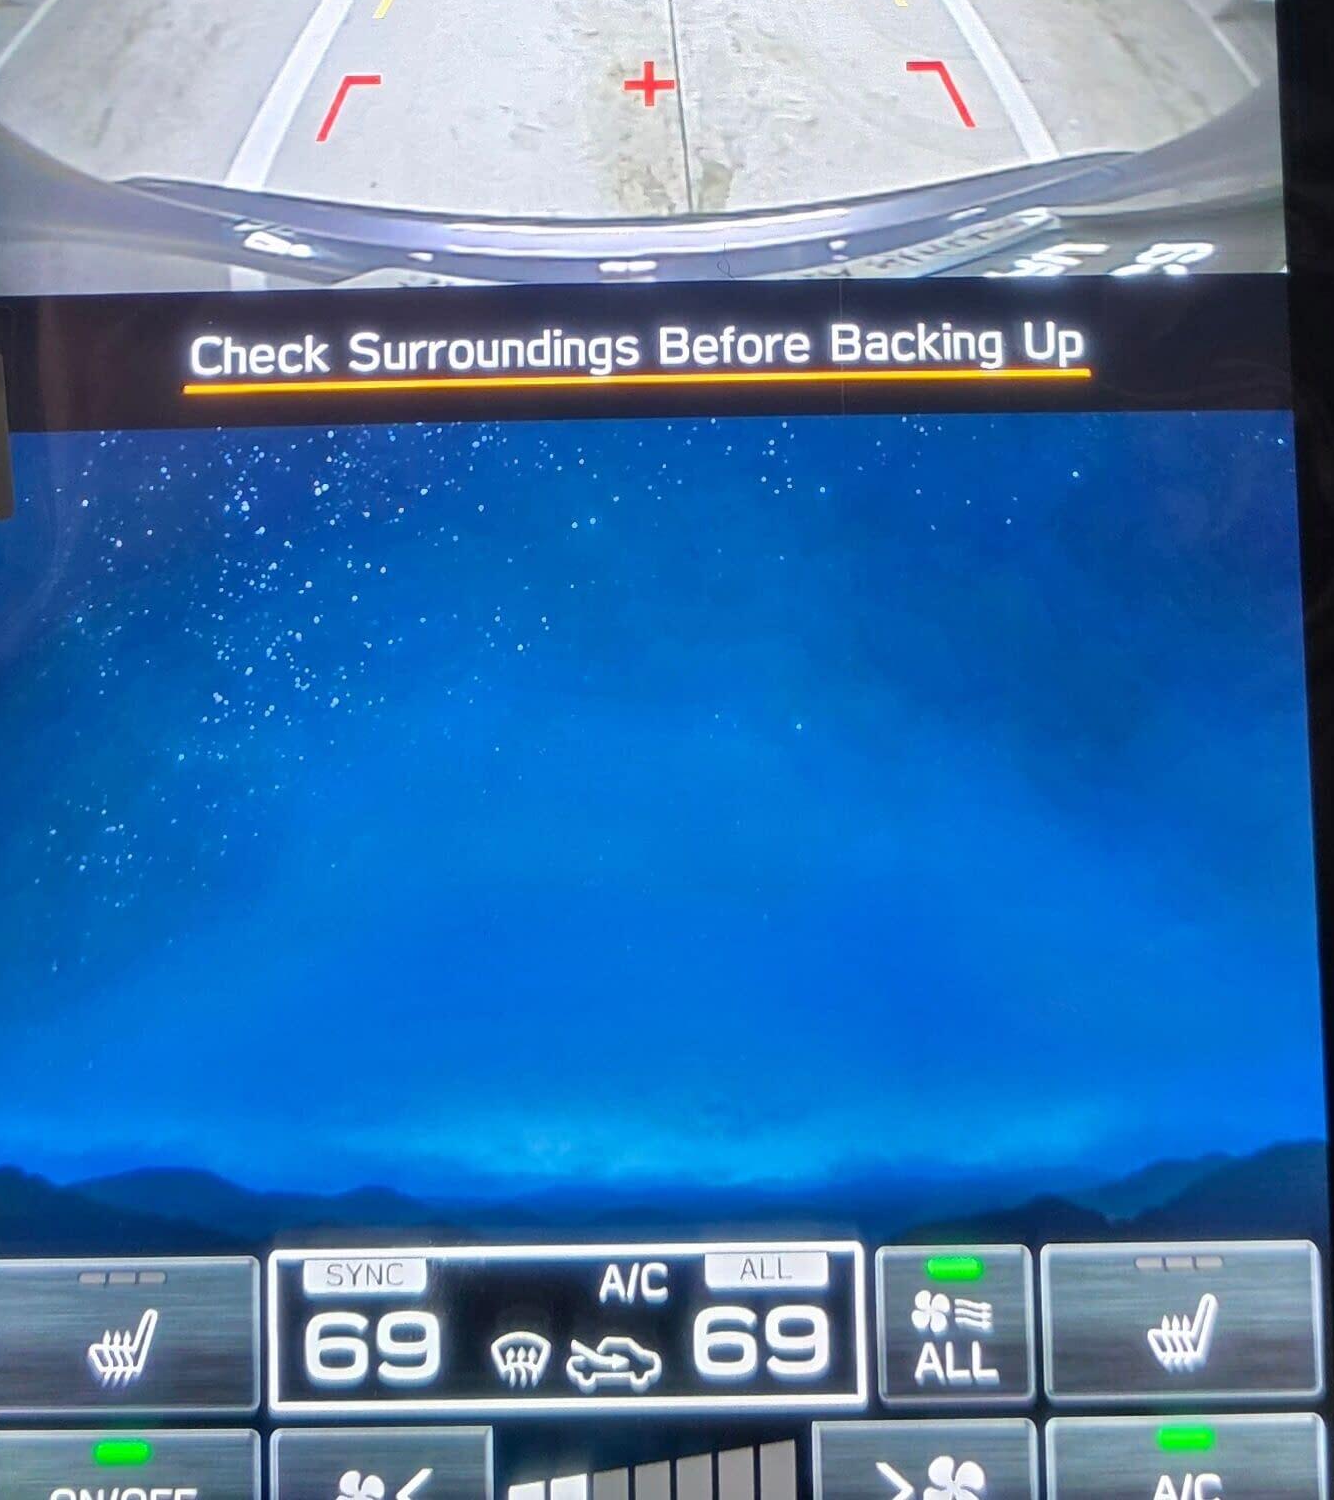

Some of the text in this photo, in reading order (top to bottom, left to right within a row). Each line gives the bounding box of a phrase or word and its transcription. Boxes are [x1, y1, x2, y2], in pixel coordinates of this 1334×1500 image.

[190, 321, 1084, 376] Check Surroundings Before Backing Up
[325, 1263, 405, 1287] SYNC
[598, 1262, 669, 1302] A/C
[739, 1257, 793, 1281] ALL
[304, 1310, 441, 1385] 69
[693, 1304, 830, 1379] 69
[914, 1341, 1000, 1386] ALL
